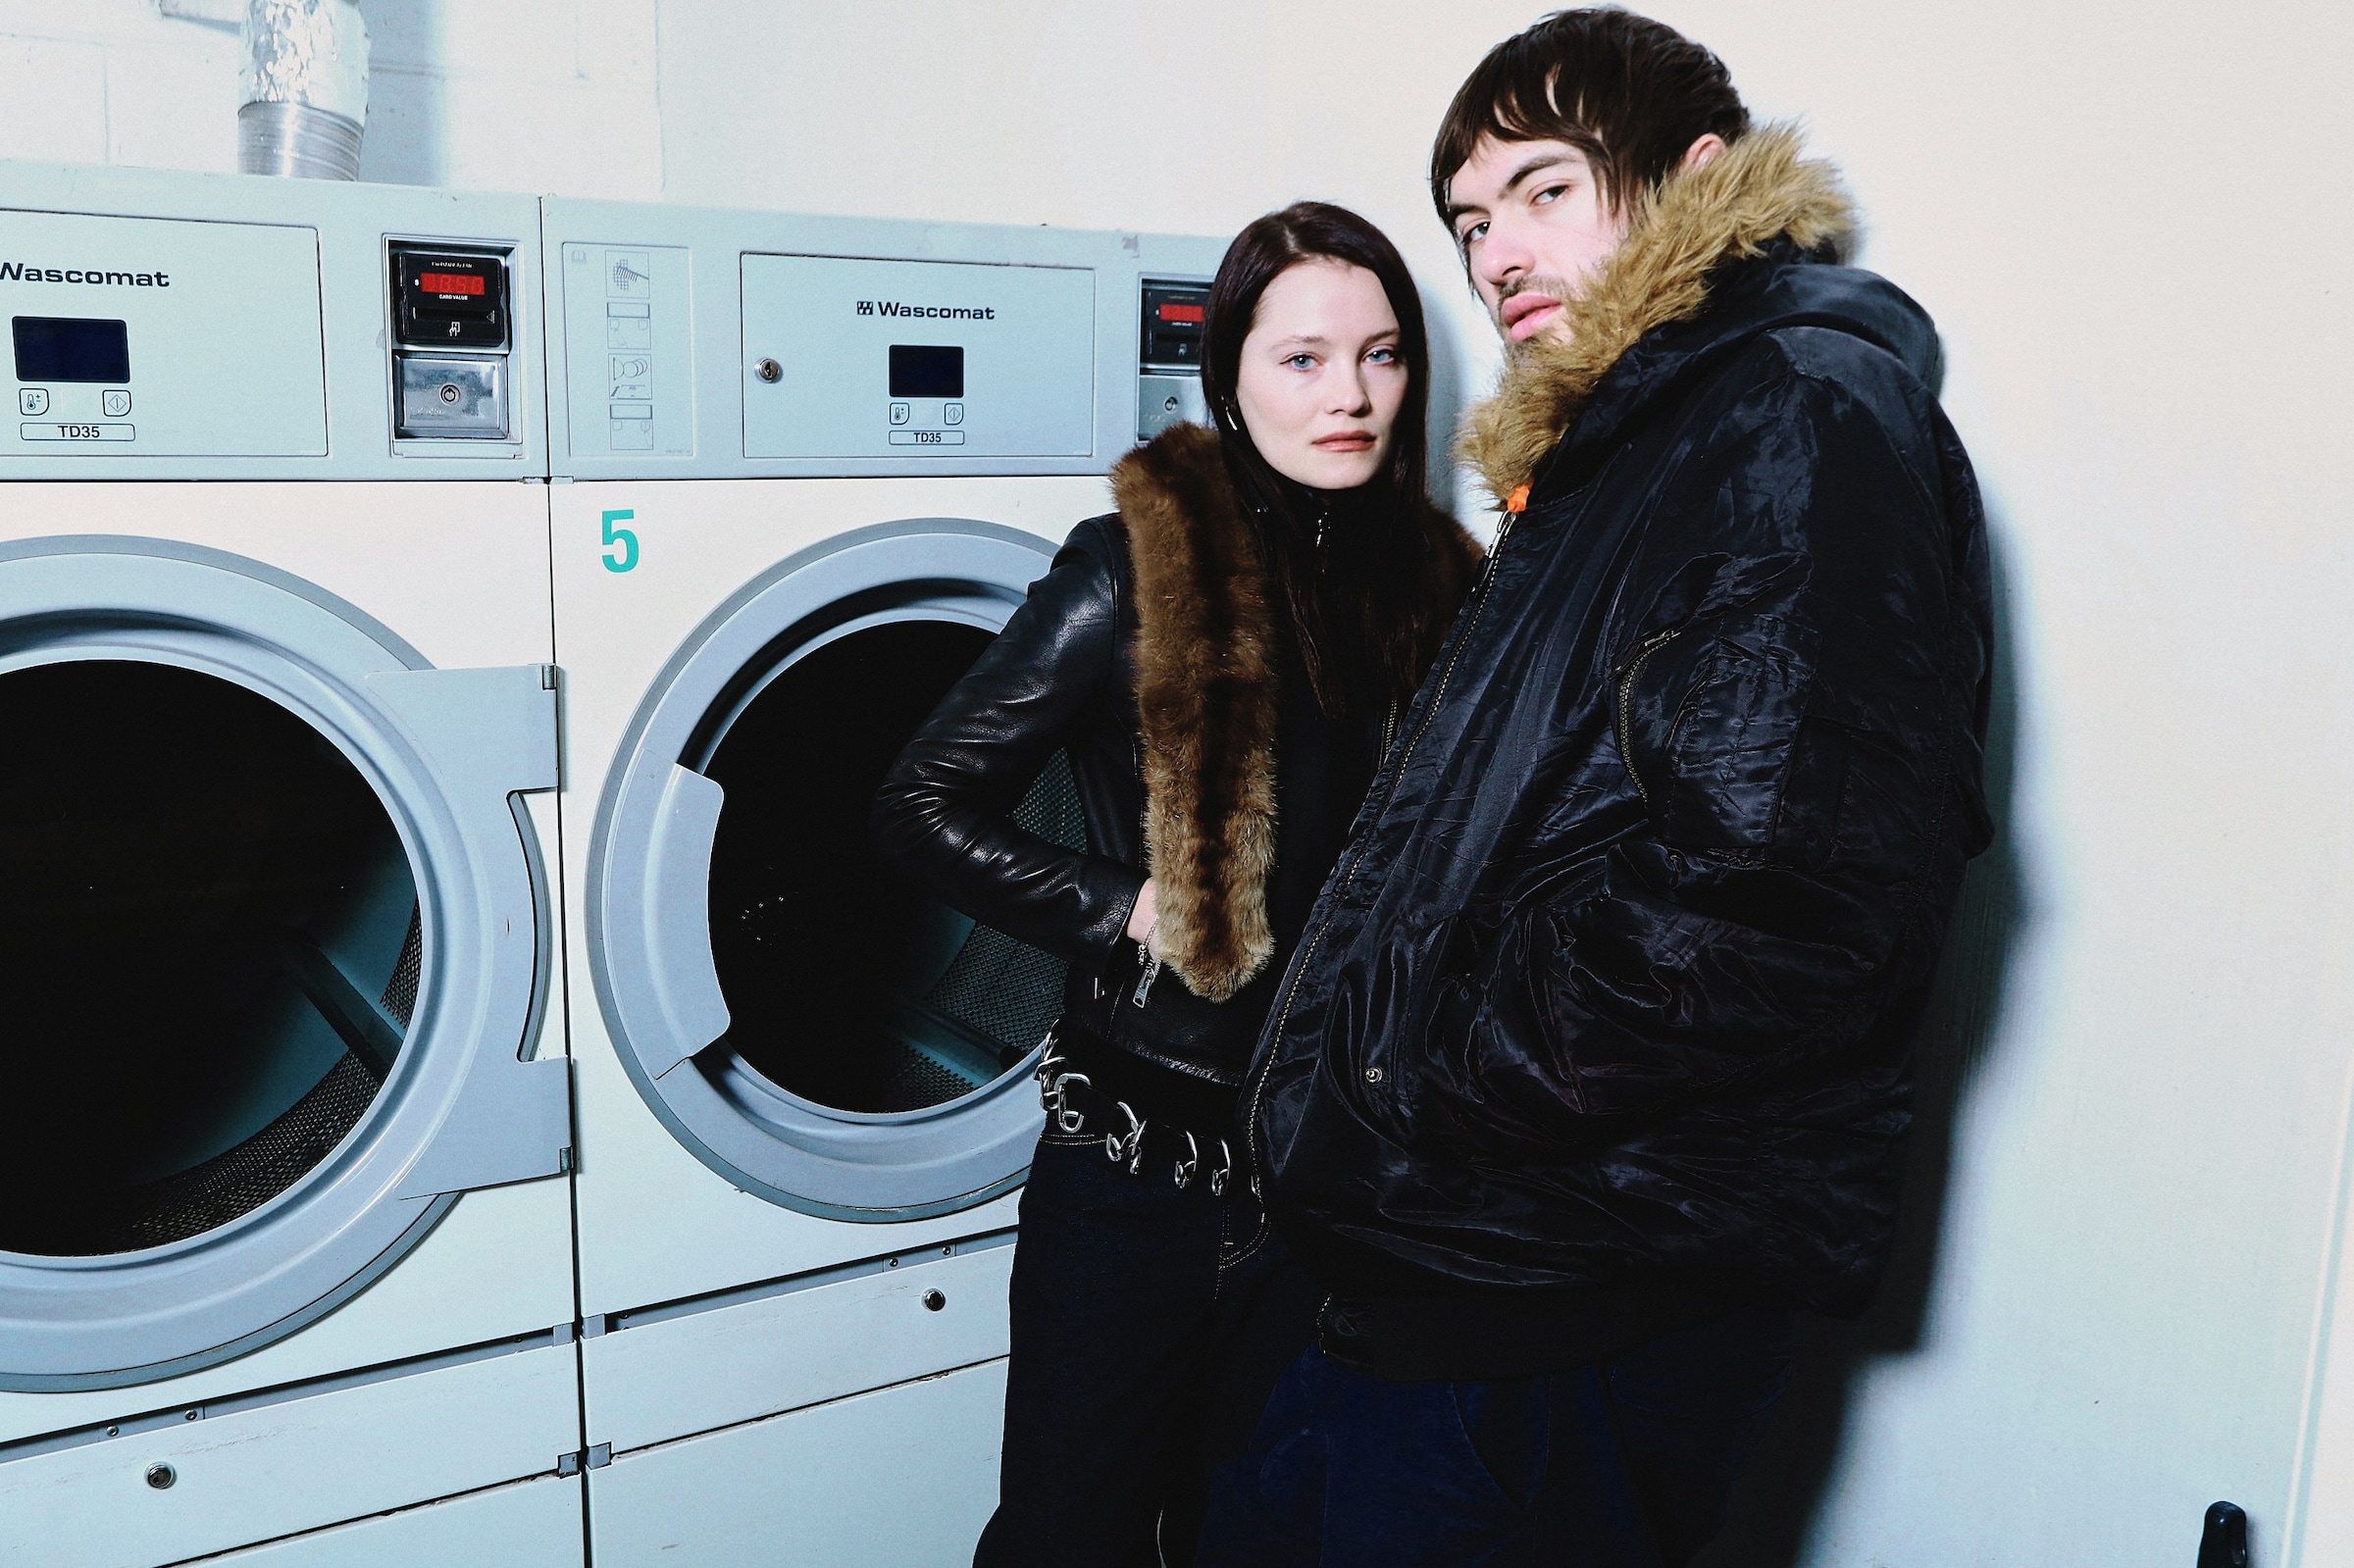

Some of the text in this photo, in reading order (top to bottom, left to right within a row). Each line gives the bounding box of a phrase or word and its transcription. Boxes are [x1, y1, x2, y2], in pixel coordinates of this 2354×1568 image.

[878, 301, 996, 321] Wascomat
[58, 425, 101, 438] TD35
[913, 432, 942, 443] TD35
[601, 509, 640, 574] 5
